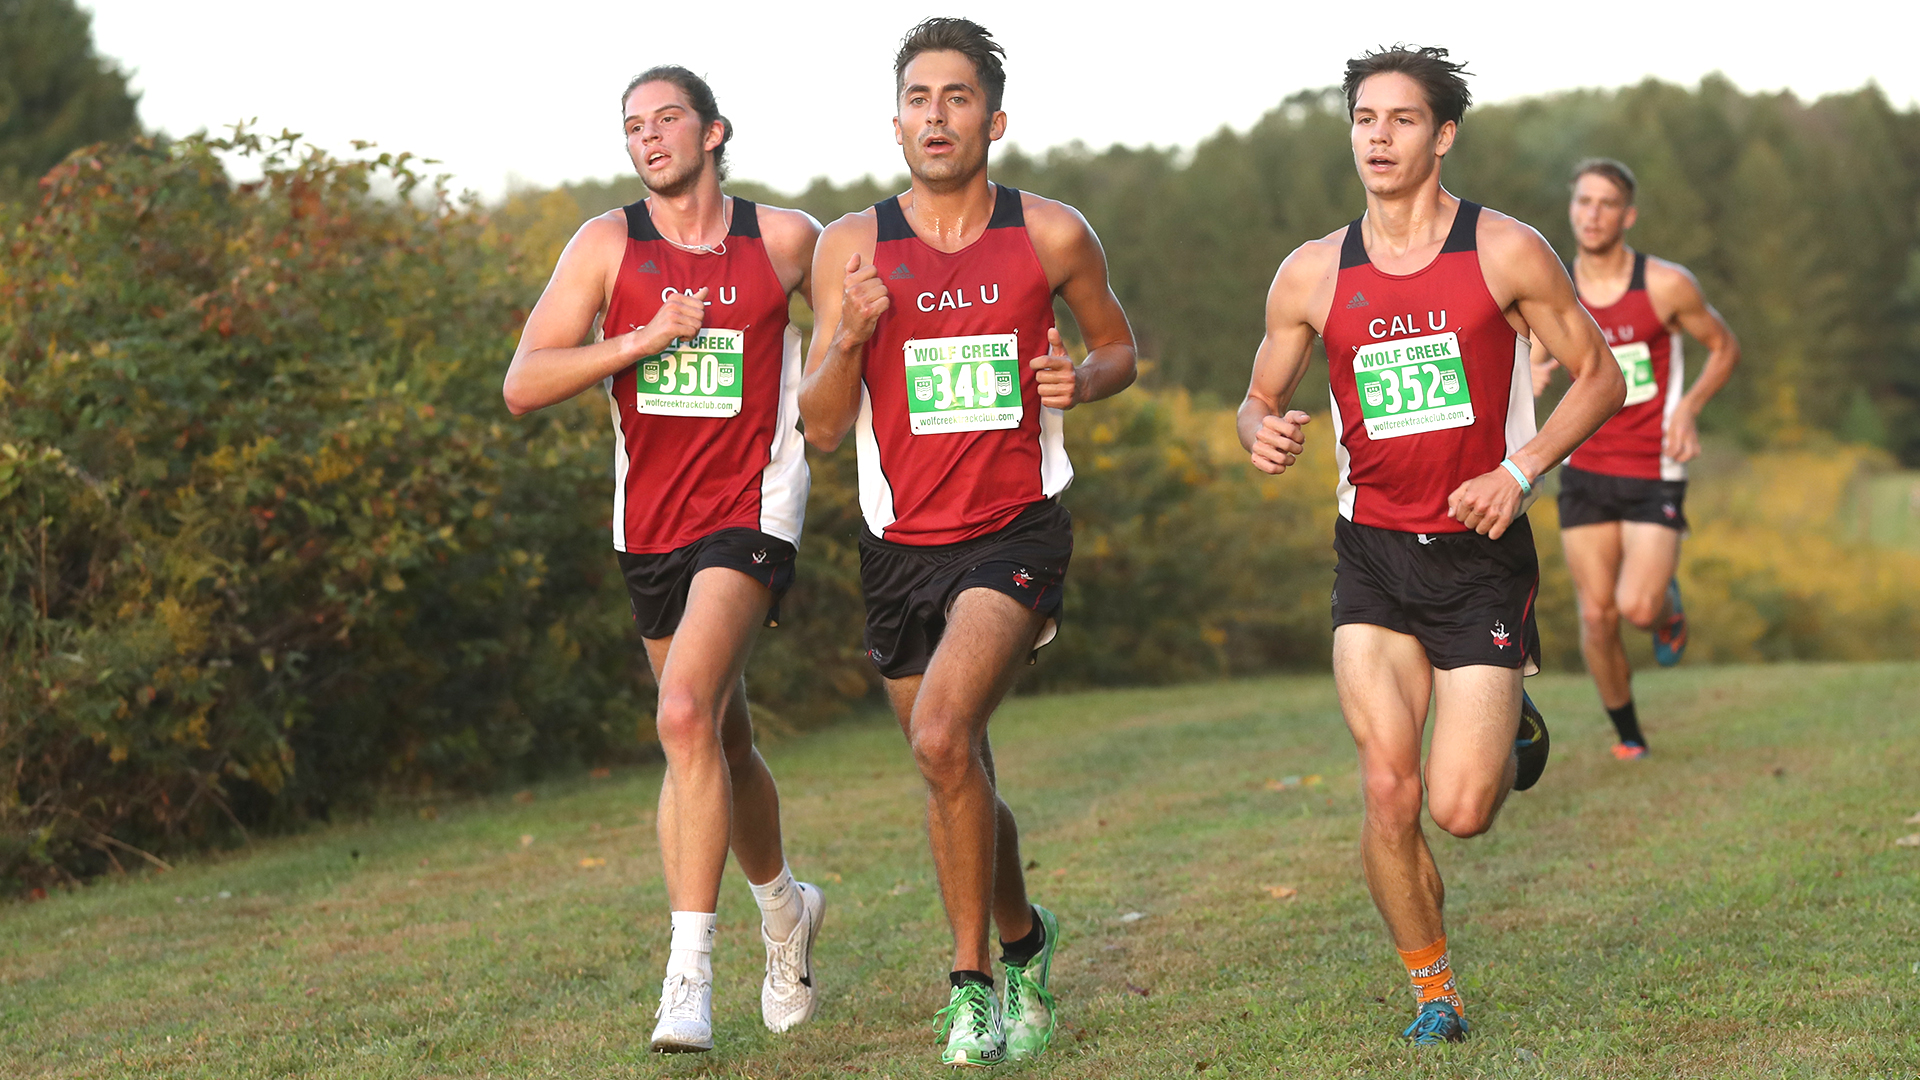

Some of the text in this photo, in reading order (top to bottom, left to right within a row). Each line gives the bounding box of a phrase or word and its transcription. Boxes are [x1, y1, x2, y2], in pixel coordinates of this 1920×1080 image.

[719, 286, 737, 305] U
[916, 283, 999, 313] CAL U
[1368, 309, 1447, 339] CAL U
[688, 335, 735, 350] CREEK
[914, 342, 1010, 363] WOLF CREEK
[1360, 341, 1452, 369] WOLF CREEK
[659, 352, 719, 396] 350
[931, 362, 998, 410] 349
[1379, 363, 1447, 414] 352
[645, 398, 733, 410] wolfcreektrackclub.com
[919, 412, 1015, 427] wolfcreektrackclub.com
[1373, 410, 1465, 432] wolfcreektrackclub.com
